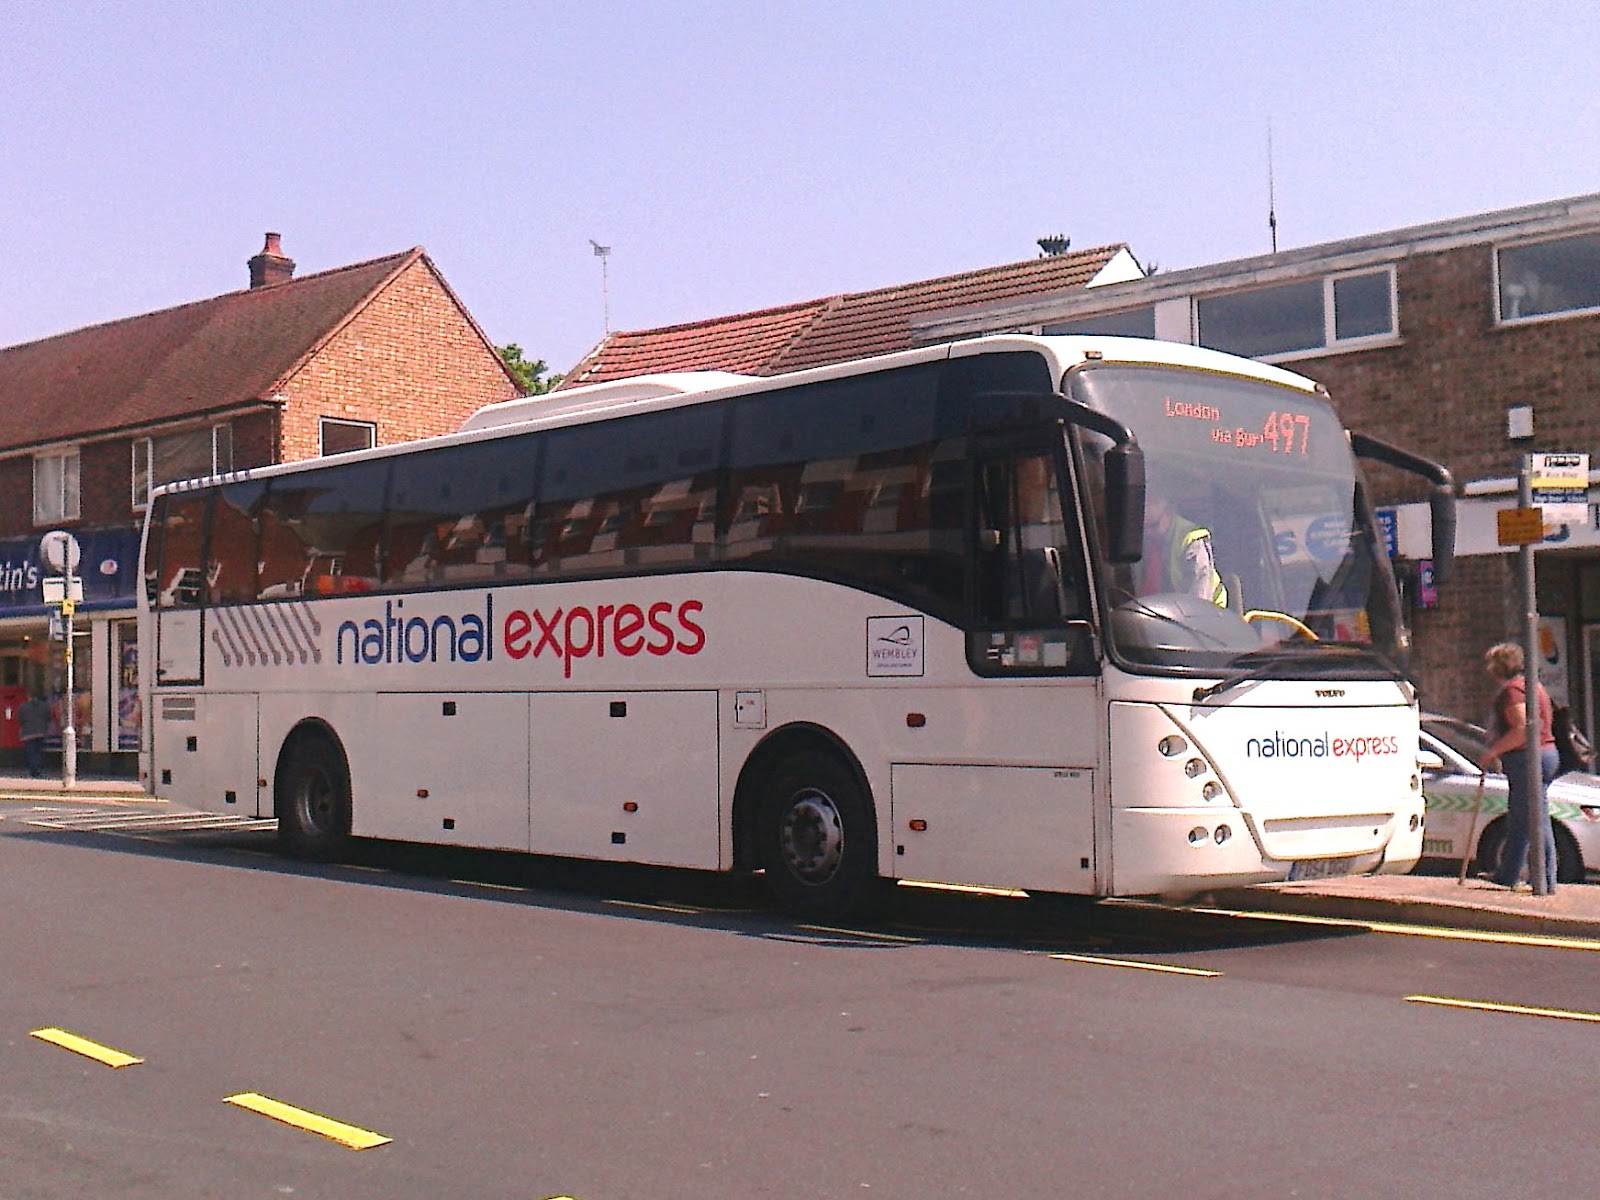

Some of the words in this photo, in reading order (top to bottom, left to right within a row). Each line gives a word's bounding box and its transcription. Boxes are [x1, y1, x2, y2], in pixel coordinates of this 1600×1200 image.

[1165, 396, 1220, 421] London
[1264, 410, 1310, 455] 497
[337, 593, 493, 664] national
[504, 600, 706, 679] express
[872, 648, 917, 659] WEMBLEY
[1315, 689, 1346, 698] VOLVO
[1247, 730, 1328, 757] national
[1332, 736, 1398, 763] express
